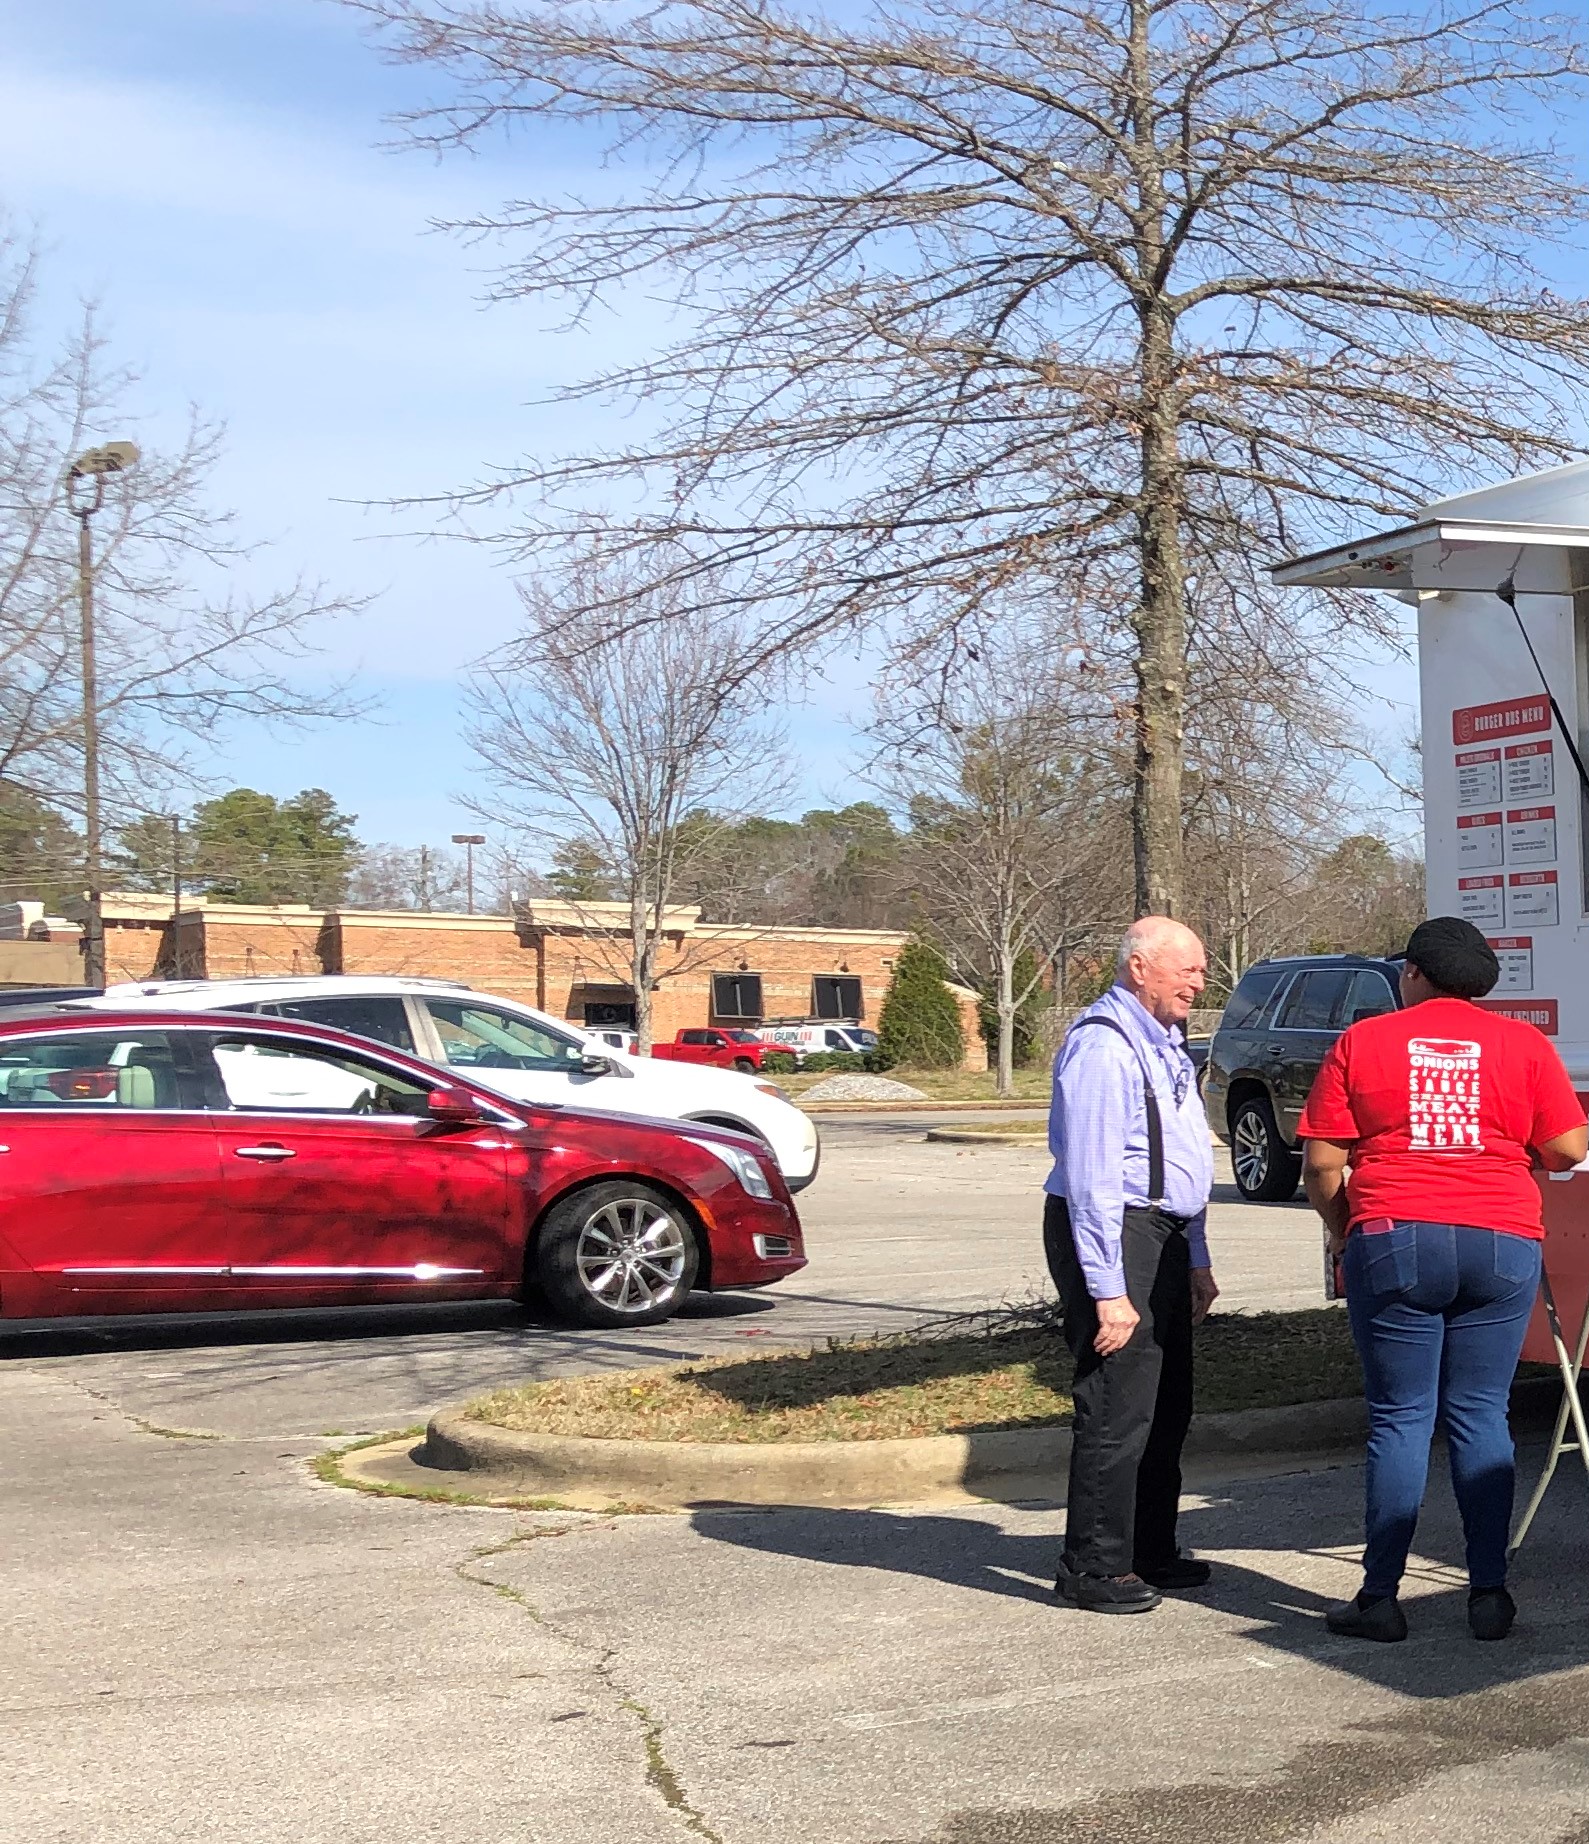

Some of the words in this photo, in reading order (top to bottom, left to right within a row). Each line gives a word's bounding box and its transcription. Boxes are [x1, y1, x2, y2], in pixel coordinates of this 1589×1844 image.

[1522, 706, 1543, 723] MENU
[1410, 1055, 1479, 1070] ONIONS
[1409, 1078, 1480, 1095] SAUCE
[1409, 1101, 1480, 1115] MEAT
[1410, 1123, 1480, 1146] MEAT
